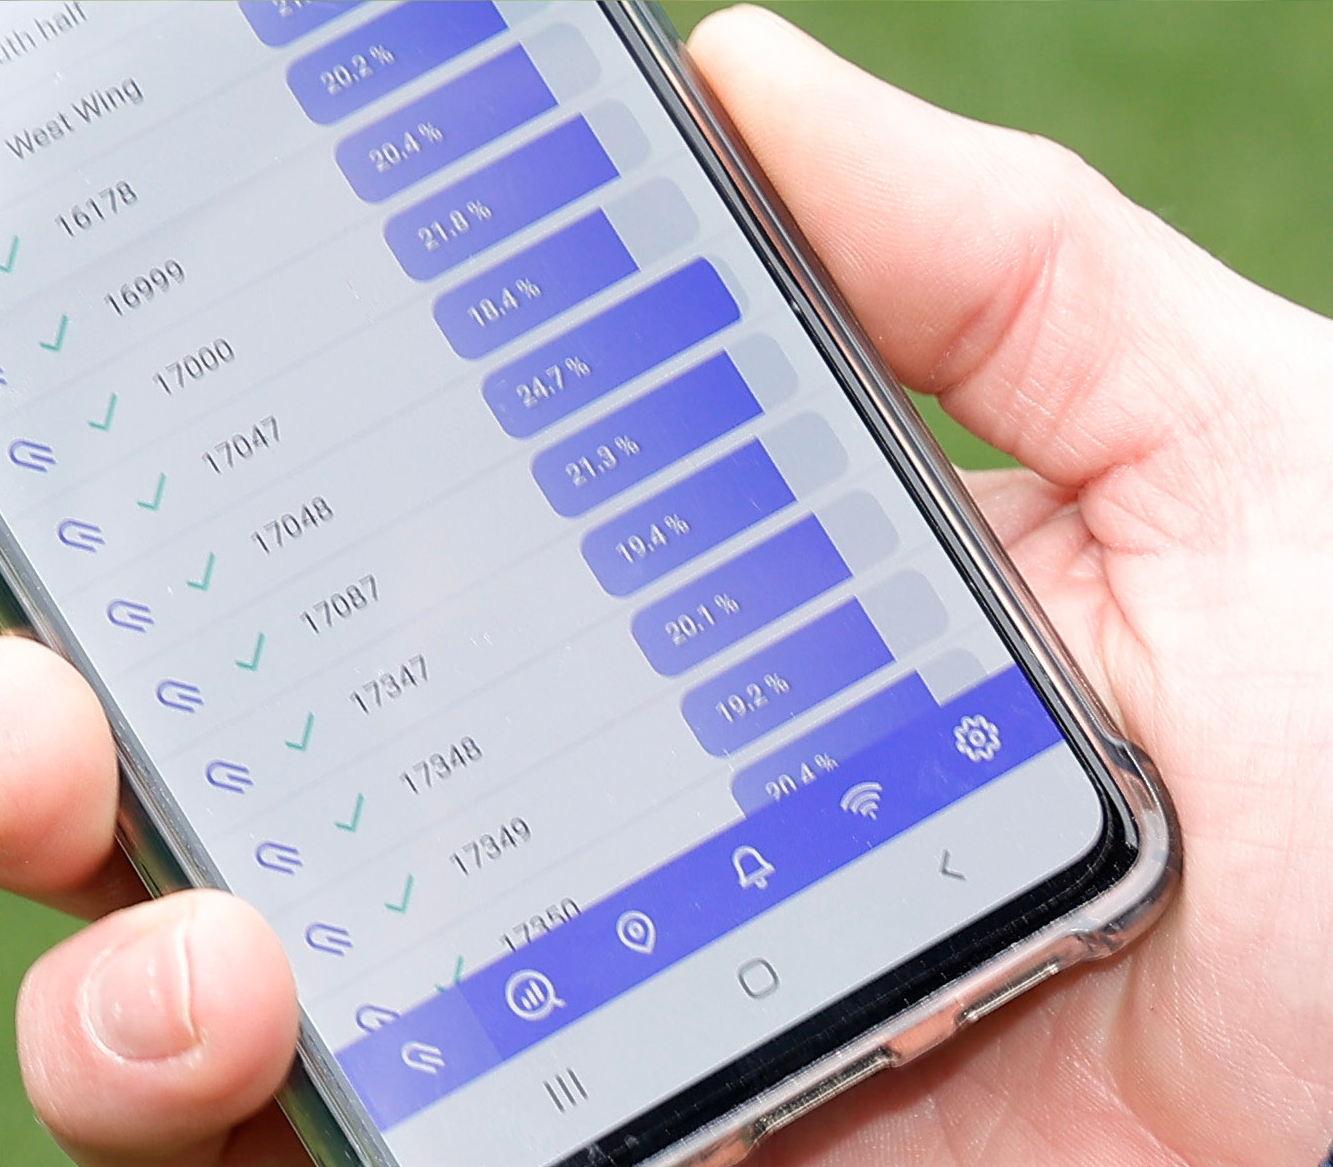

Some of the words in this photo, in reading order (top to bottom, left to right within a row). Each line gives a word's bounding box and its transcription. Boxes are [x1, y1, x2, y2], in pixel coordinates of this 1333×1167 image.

[320, 53, 374, 95] 20.2
[369, 44, 396, 65] %
[4, 110, 76, 160] West
[71, 76, 145, 124] Wing
[367, 131, 421, 174] 20.4
[417, 121, 445, 144] %
[53, 179, 138, 238] 16178
[416, 209, 471, 252] 21.8
[465, 199, 493, 221] %
[102, 258, 187, 318] 16999
[466, 286, 520, 329] 18.4
[515, 276, 543, 299] %
[151, 337, 236, 396] 17000
[515, 364, 569, 410] 24.7
[564, 355, 592, 378] %
[200, 414, 282, 476] 17047
[564, 444, 619, 488] 21.3
[613, 434, 641, 457] %
[249, 495, 335, 555] 17048
[614, 522, 668, 565] 19.4
[663, 512, 691, 535] %
[298, 573, 382, 635] 17087
[664, 603, 719, 647] 20.1
[713, 592, 741, 615] %
[348, 654, 431, 716] 17347
[714, 680, 770, 724] 19.2
[763, 671, 791, 696] %
[398, 735, 484, 797] 17348
[764, 761, 818, 801] 204
[447, 815, 533, 878] 17349
[498, 896, 583, 953] 17350
